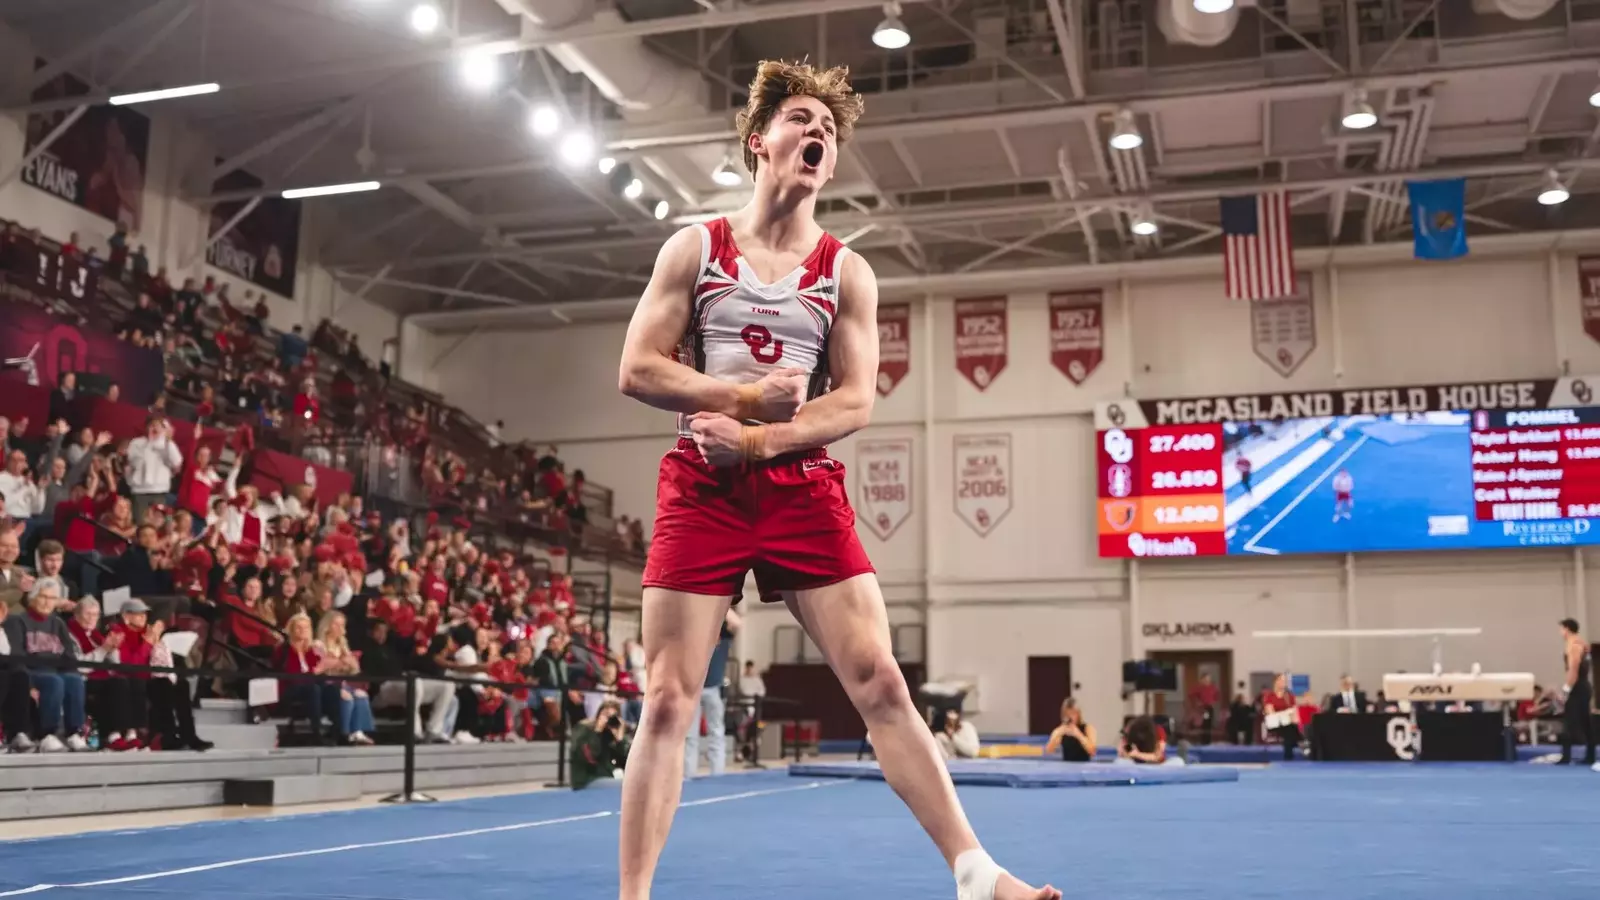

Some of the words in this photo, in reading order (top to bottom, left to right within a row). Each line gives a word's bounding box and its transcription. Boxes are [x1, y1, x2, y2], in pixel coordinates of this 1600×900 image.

[751, 306, 780, 317] TURN
[1056, 310, 1096, 329] 1957
[962, 315, 1002, 336] 1952
[740, 323, 784, 365] OU
[1342, 387, 1427, 415] FIELD
[1438, 382, 1536, 411] HOUSE
[1149, 433, 1216, 453] 27.400
[862, 483, 906, 502] 1988
[958, 479, 1006, 498] 2006
[1142, 622, 1234, 638] OKLAHOMA
